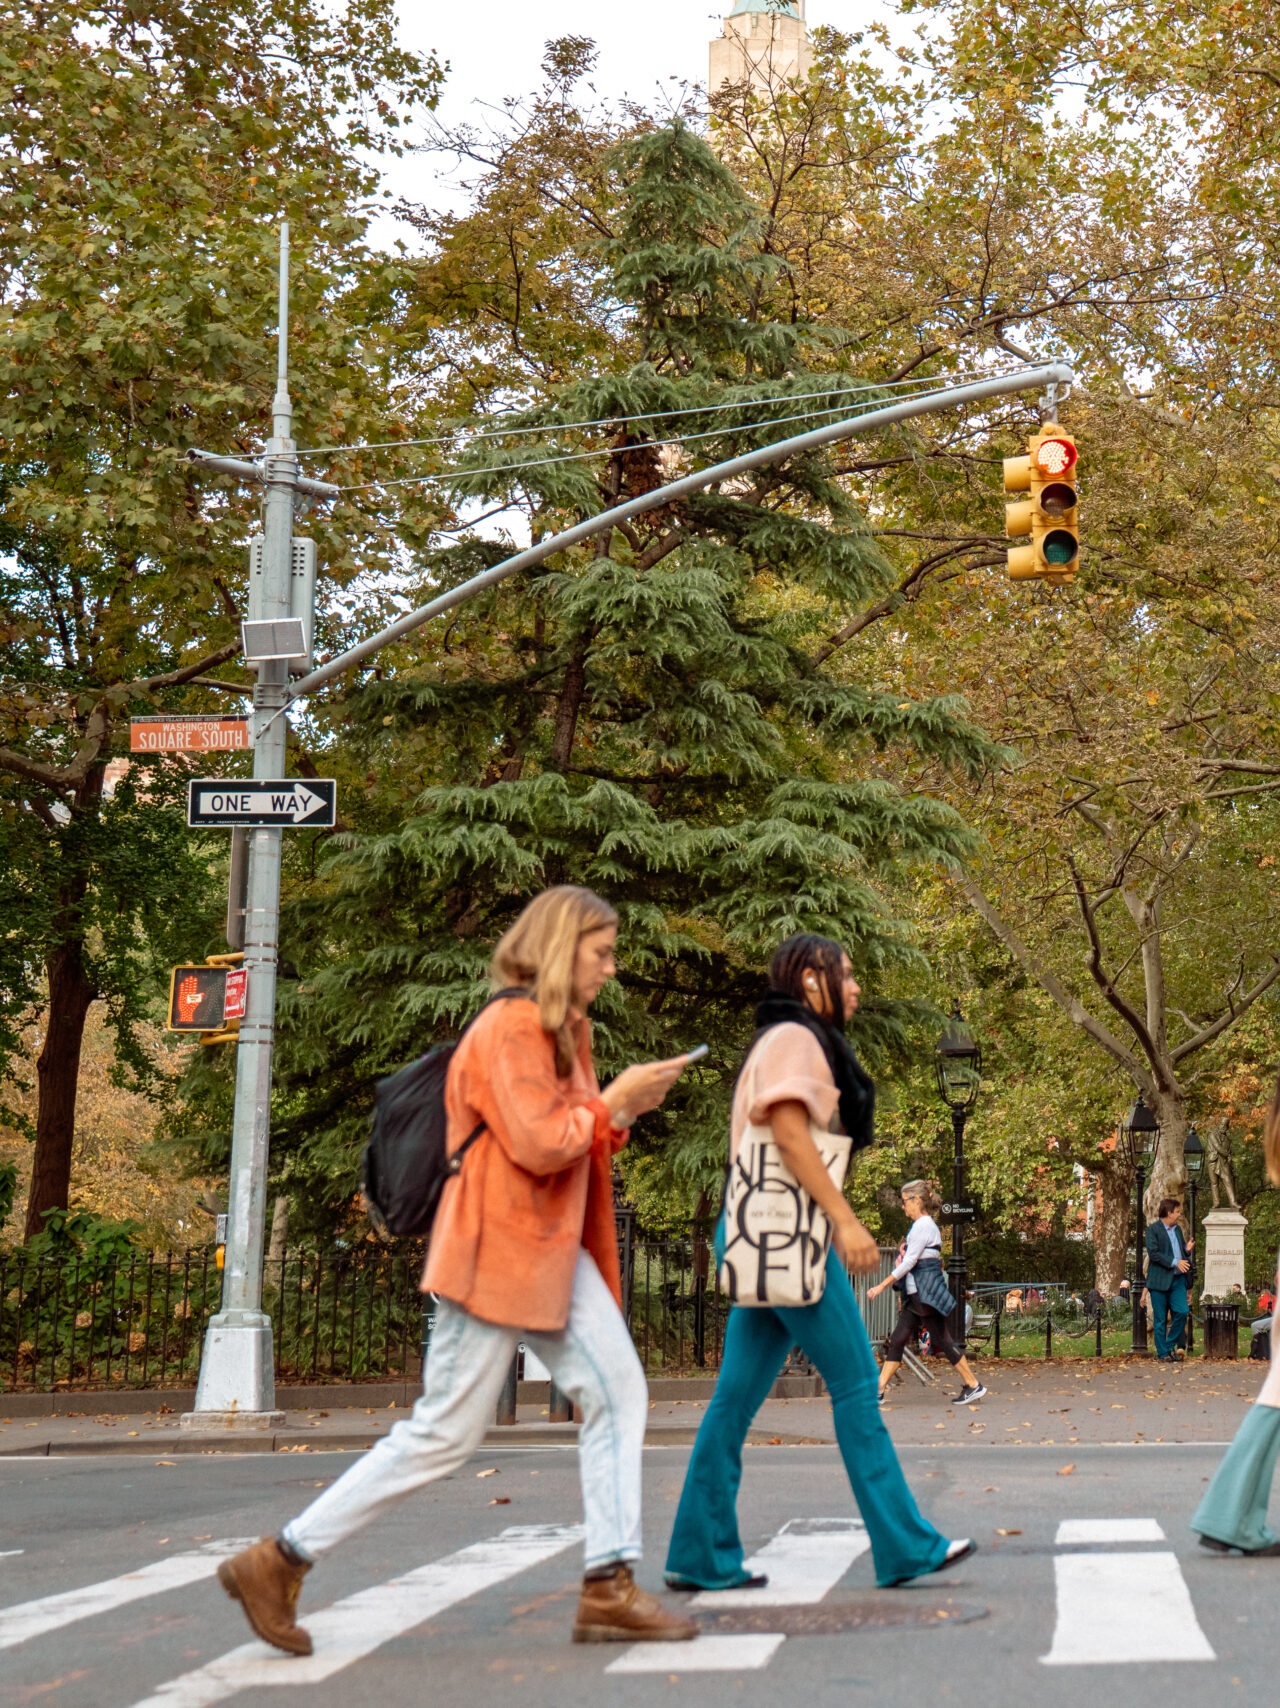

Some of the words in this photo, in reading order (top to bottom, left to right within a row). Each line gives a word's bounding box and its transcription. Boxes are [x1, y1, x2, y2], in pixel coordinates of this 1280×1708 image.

[162, 722, 220, 731] WASHINGTON
[139, 731, 193, 749] SQUARE
[201, 730, 243, 748] SOUTH
[211, 795, 252, 812] ONE
[271, 794, 312, 812] WAY
